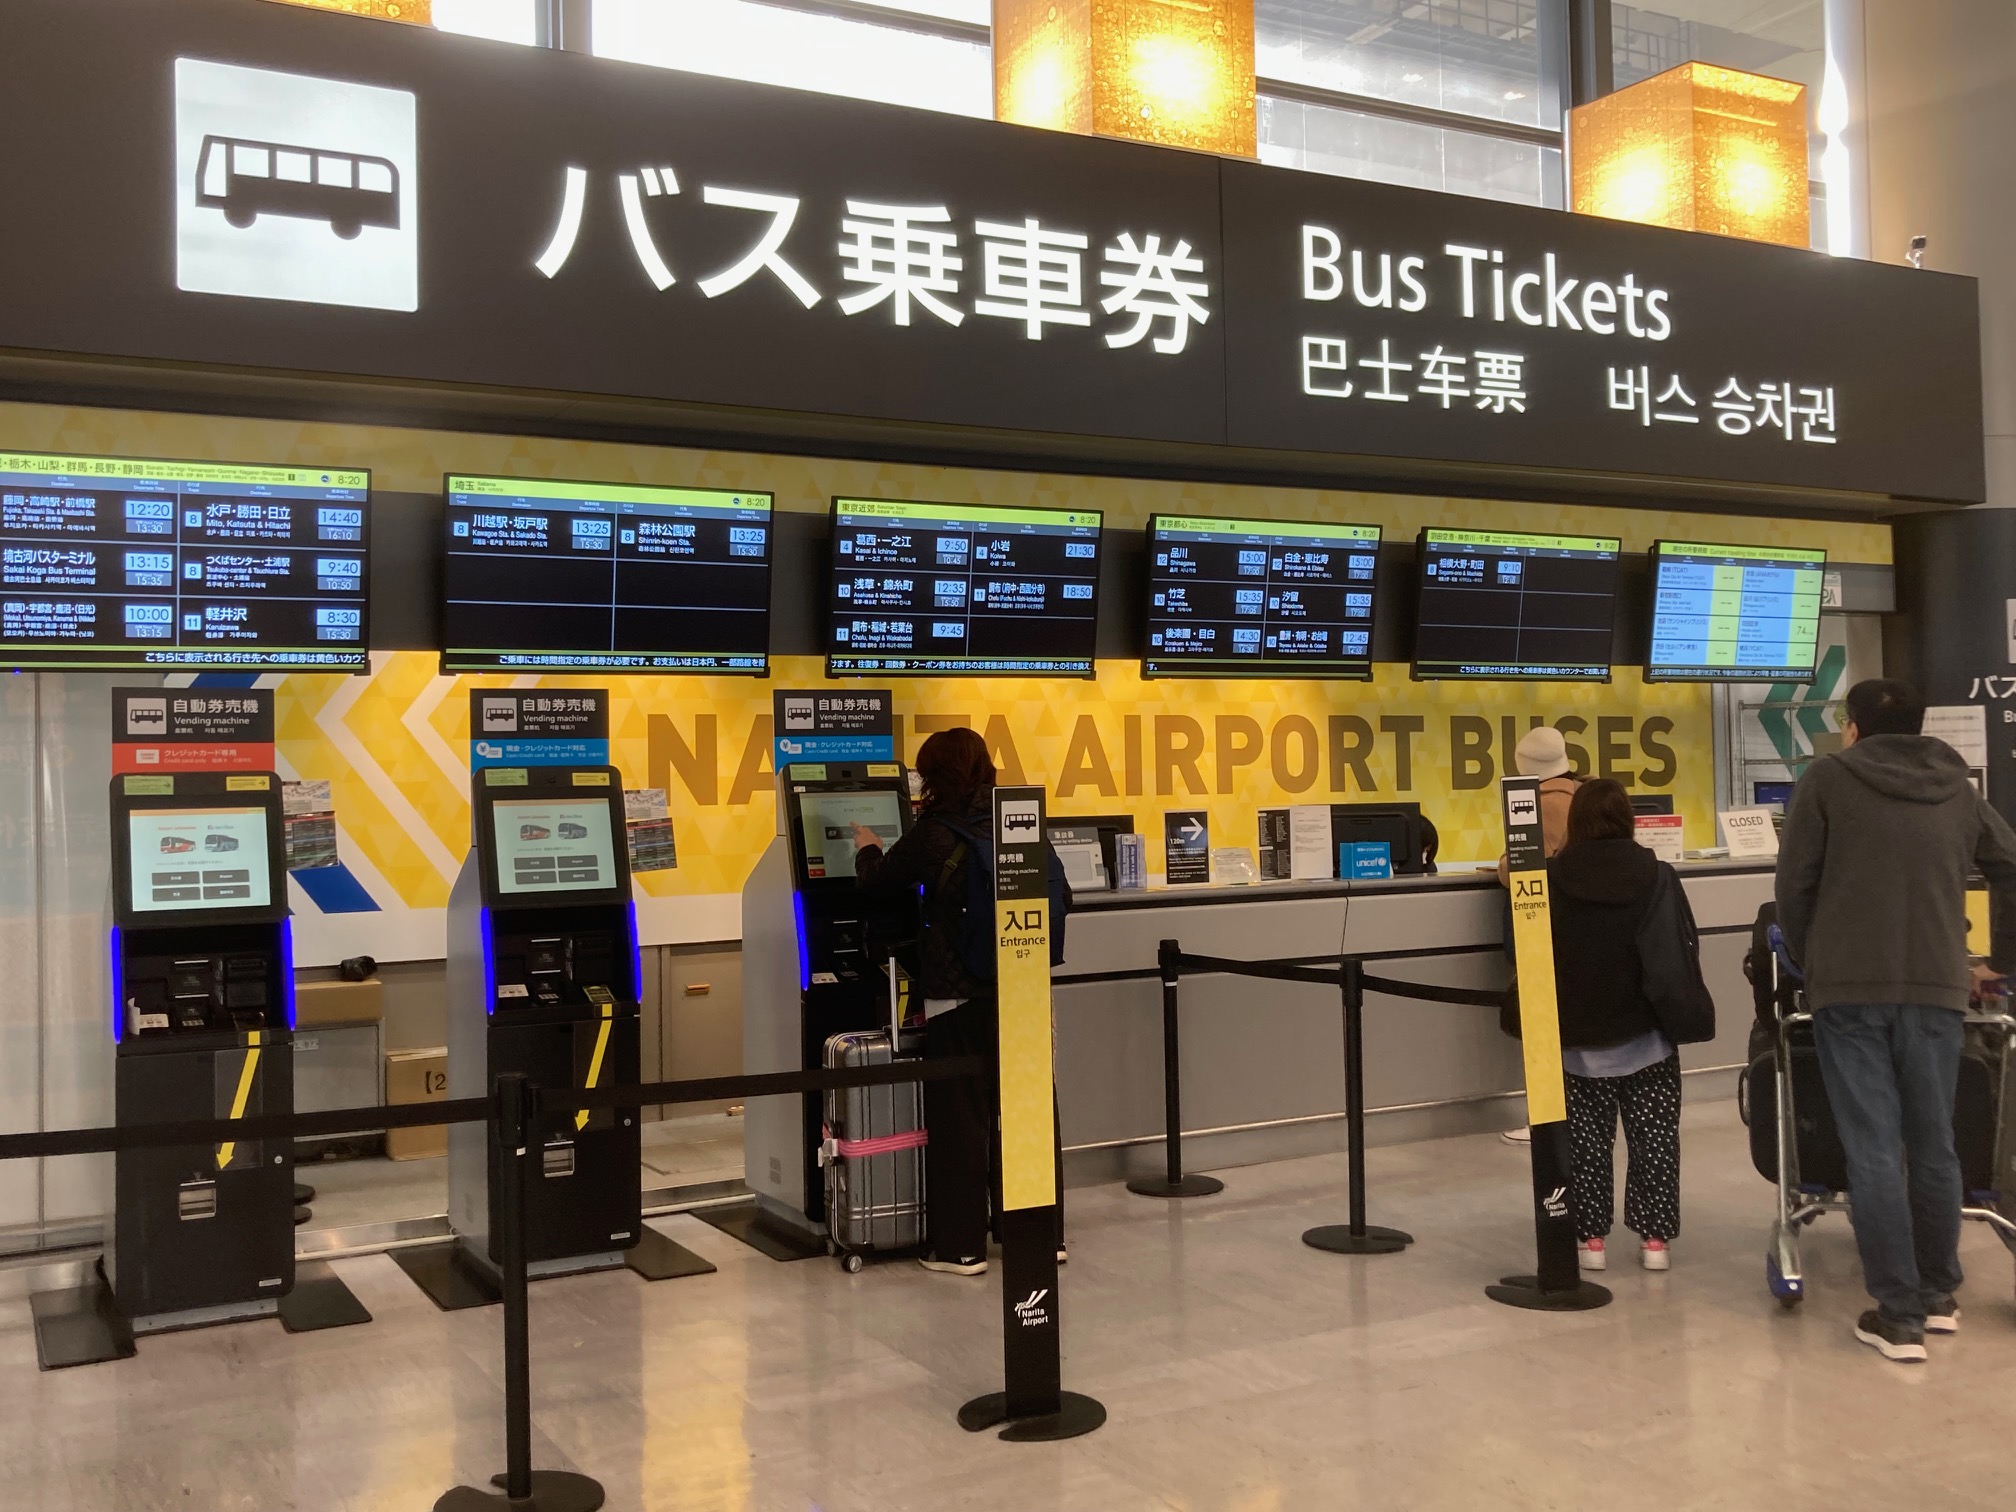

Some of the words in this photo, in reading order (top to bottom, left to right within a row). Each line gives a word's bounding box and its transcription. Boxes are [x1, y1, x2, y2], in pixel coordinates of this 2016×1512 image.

[535, 164, 1211, 356] バス乗車券
[1302, 224, 1427, 313] Bus
[1445, 244, 1672, 342] Tickets
[1302, 336, 1527, 414] 巴士车票
[1608, 365, 1699, 426] 버스
[1713, 378, 1837, 444] 승차권
[0, 458, 143, 475] ・栃木・山梨・群馬・長野・静岡
[338, 476, 360, 485] 8:20
[455, 481, 474, 491] 埼玉
[747, 498, 765, 507] 8:20
[129, 503, 170, 516] 12:20
[206, 504, 291, 520] 水戸・勝田・日立
[842, 503, 875, 513] 東京近郊
[190, 515, 197, 524] 8
[322, 512, 359, 524] 14:40
[472, 514, 548, 530] 川越駅・坂戸駅
[1080, 516, 1096, 524] 8:20
[136, 524, 162, 533] 13:30
[227, 520, 255, 529] Katsuta
[265, 521, 291, 530] Hitachi
[458, 525, 464, 534] 8
[576, 522, 609, 535] 13:25
[638, 523, 696, 537] 森林公園駅
[328, 532, 352, 540] 16:10
[624, 533, 631, 541] 8
[638, 537, 677, 545] Shinrin-koen
[733, 530, 763, 542] 13:25
[855, 534, 911, 547] 葛西・一之江
[581, 541, 602, 549] 15:30
[945, 540, 966, 551] 9:50
[991, 540, 1010, 552] 小岩
[737, 548, 757, 556] 15:30
[1068, 547, 1093, 556] 21:30
[1170, 547, 1188, 559] 品川
[3, 549, 95, 565] 境古河バスターミナル
[206, 556, 290, 567] つくばセンター・土浦駅
[1241, 553, 1264, 562] 15:00
[130, 556, 169, 569] 13:15
[328, 562, 358, 573] 9:40
[1351, 558, 1373, 567] 15:00
[1504, 563, 1520, 572] 9:10
[3, 566, 25, 574] Sakai
[27, 566, 46, 576] Koga
[48, 567, 62, 575] Bus
[190, 567, 197, 575] 8
[136, 577, 162, 585] 15:35
[327, 581, 351, 589] 10:50
[841, 587, 849, 595] 10
[937, 583, 964, 593] 12:35
[1066, 587, 1091, 597] 18:50
[976, 591, 983, 599] 11
[1168, 588, 1186, 599] 竹芝
[1239, 592, 1261, 601] 15:35
[1156, 596, 1164, 604] 10
[1348, 596, 1370, 605] 15:35
[130, 608, 169, 621] 10:00
[205, 607, 247, 621] 軽井沢
[328, 612, 357, 623] 8:30
[188, 619, 198, 627] 11
[136, 628, 162, 637] 13:15
[940, 625, 962, 635] 9:45
[1797, 626, 1806, 635] 74
[327, 631, 351, 640] 15:30
[1236, 632, 1259, 641] 14:30
[1346, 634, 1367, 642] 12:45
[174, 699, 259, 713] 自動券売機
[523, 699, 596, 712] 自動券売機
[819, 699, 881, 711] 自動券売機
[174, 717, 211, 726] Vending
[213, 717, 250, 725] machine
[524, 715, 555, 724] Vending
[1055, 714, 1428, 797] AIRPORT
[1730, 816, 1763, 828] CLOSED
[999, 853, 1024, 864] 券売機
[1356, 857, 1378, 867] unicef
[1517, 880, 1543, 897] 入口
[1514, 901, 1547, 911] Entrance
[1526, 911, 1536, 919] 입구
[1004, 910, 1042, 931] 入口
[1000, 936, 1045, 947] Entrance
[1016, 949, 1030, 959] 입구
[1022, 1308, 1045, 1318] Narita
[1023, 1315, 1048, 1327] Airport
